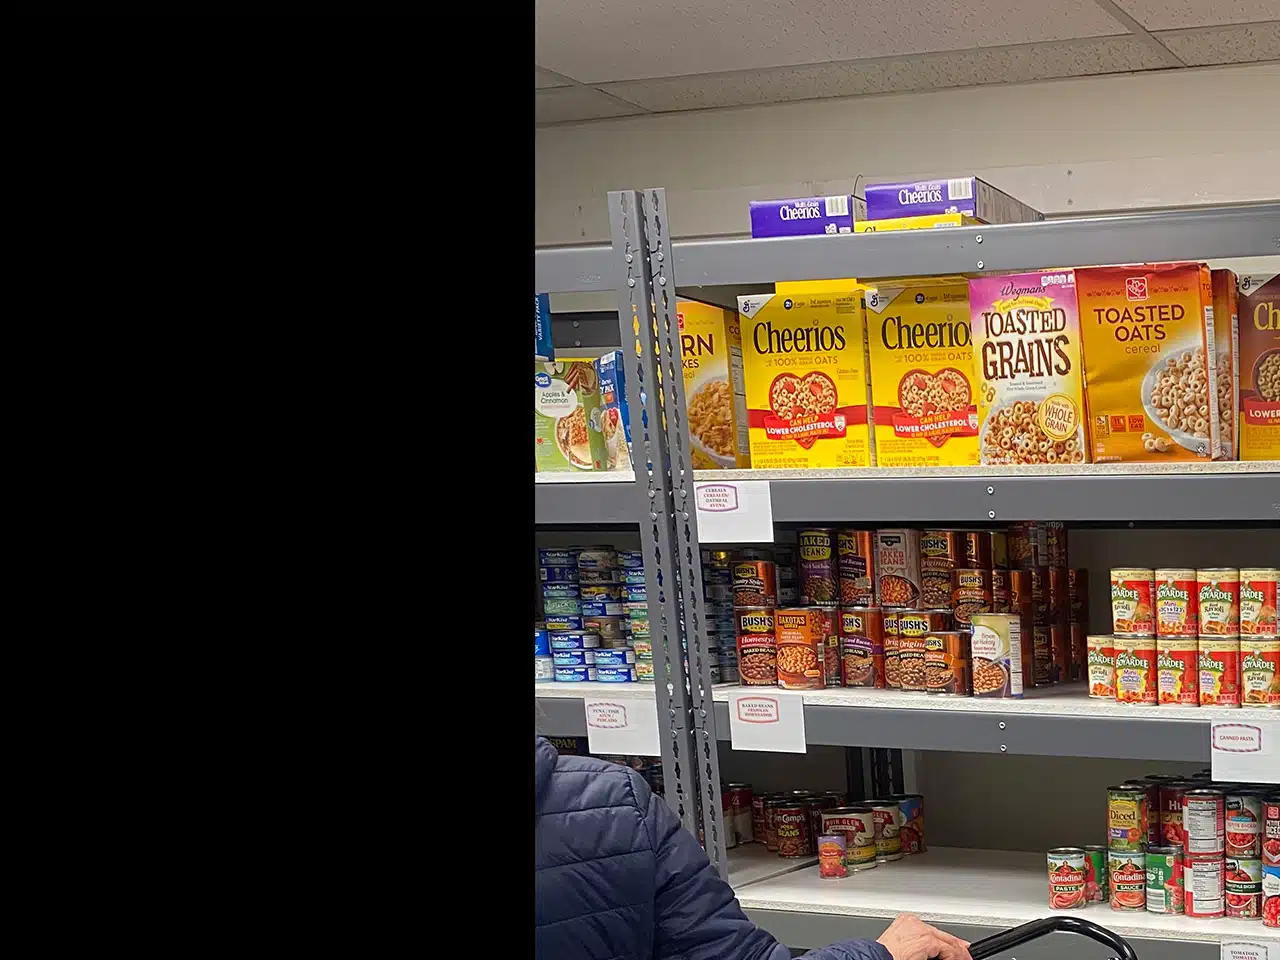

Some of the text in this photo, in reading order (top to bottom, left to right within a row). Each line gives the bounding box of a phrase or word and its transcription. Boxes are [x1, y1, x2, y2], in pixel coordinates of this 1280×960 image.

[899, 189, 943, 205] Cheerios
[780, 205, 821, 221] Cheerios
[1000, 284, 1046, 301] Wegmans
[1093, 304, 1185, 325] TOASTED
[981, 307, 1067, 339] TOASTED
[753, 319, 846, 354] Cheerios
[1114, 324, 1166, 342] OATS
[1125, 344, 1161, 355] cereal
[814, 355, 839, 365] OATS
[947, 352, 973, 361] OATS
[981, 334, 1072, 381] GRAINS
[919, 413, 952, 424] CAN HELP
[1045, 406, 1073, 423] WHOLE
[1250, 407, 1280, 418] LOWER
[789, 415, 819, 427] CAN HELP
[895, 419, 968, 433] LOWER CHOLESTEROL
[1045, 418, 1068, 433] GRAIN
[767, 421, 835, 435] LOWER CHOLESTEROL
[735, 567, 755, 575] BUSH'S
[960, 576, 983, 585] BUSH'S
[742, 616, 773, 627] BUSH'S
[900, 619, 928, 631] BUSH'S
[1110, 810, 1136, 820] Diced
[1050, 872, 1082, 883] Contadina
